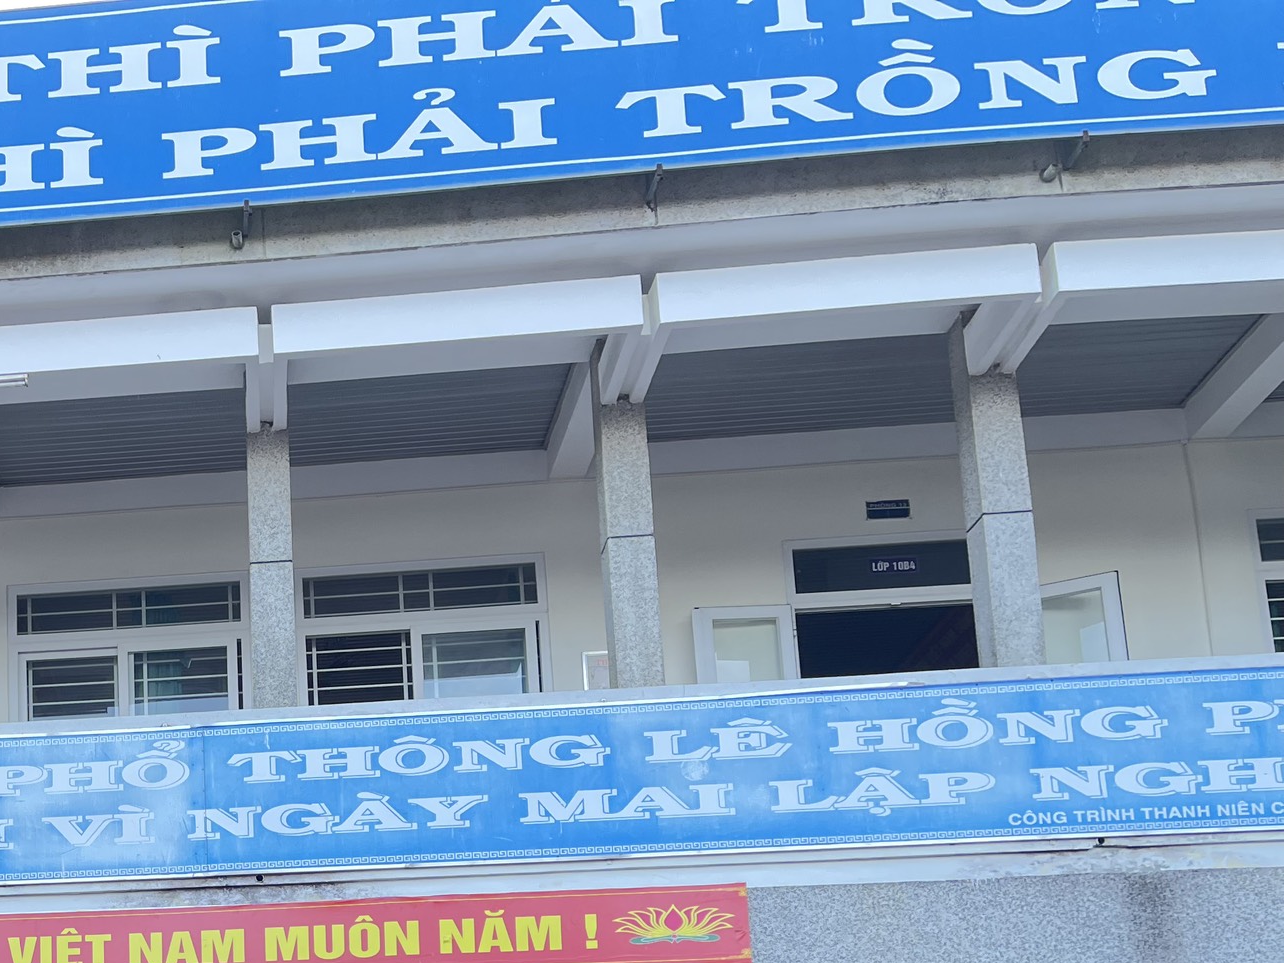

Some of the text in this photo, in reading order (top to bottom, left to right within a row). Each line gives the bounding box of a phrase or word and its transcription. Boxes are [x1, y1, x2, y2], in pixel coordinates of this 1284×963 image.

[162, 88, 558, 179] PHẢI
[615, 39, 1217, 138] TRỒNG
[872, 560, 916, 571] LỚP 10B4
[227, 733, 611, 784] THÔNG
[643, 717, 794, 764] LÊ
[827, 698, 1169, 753] HỒNG
[41, 804, 156, 846] VÌ
[187, 792, 489, 841] NGÀY
[518, 783, 736, 825] MAI
[768, 767, 997, 817] LẬP
[1008, 811, 1068, 827] CÔNG
[1073, 807, 1135, 823] TRÌNH
[1140, 805, 1211, 820] THANH
[1217, 801, 1265, 817] NIÊN
[264, 917, 422, 963] MUÔN
[438, 908, 564, 955] NĂM
[584, 913, 599, 949] !
